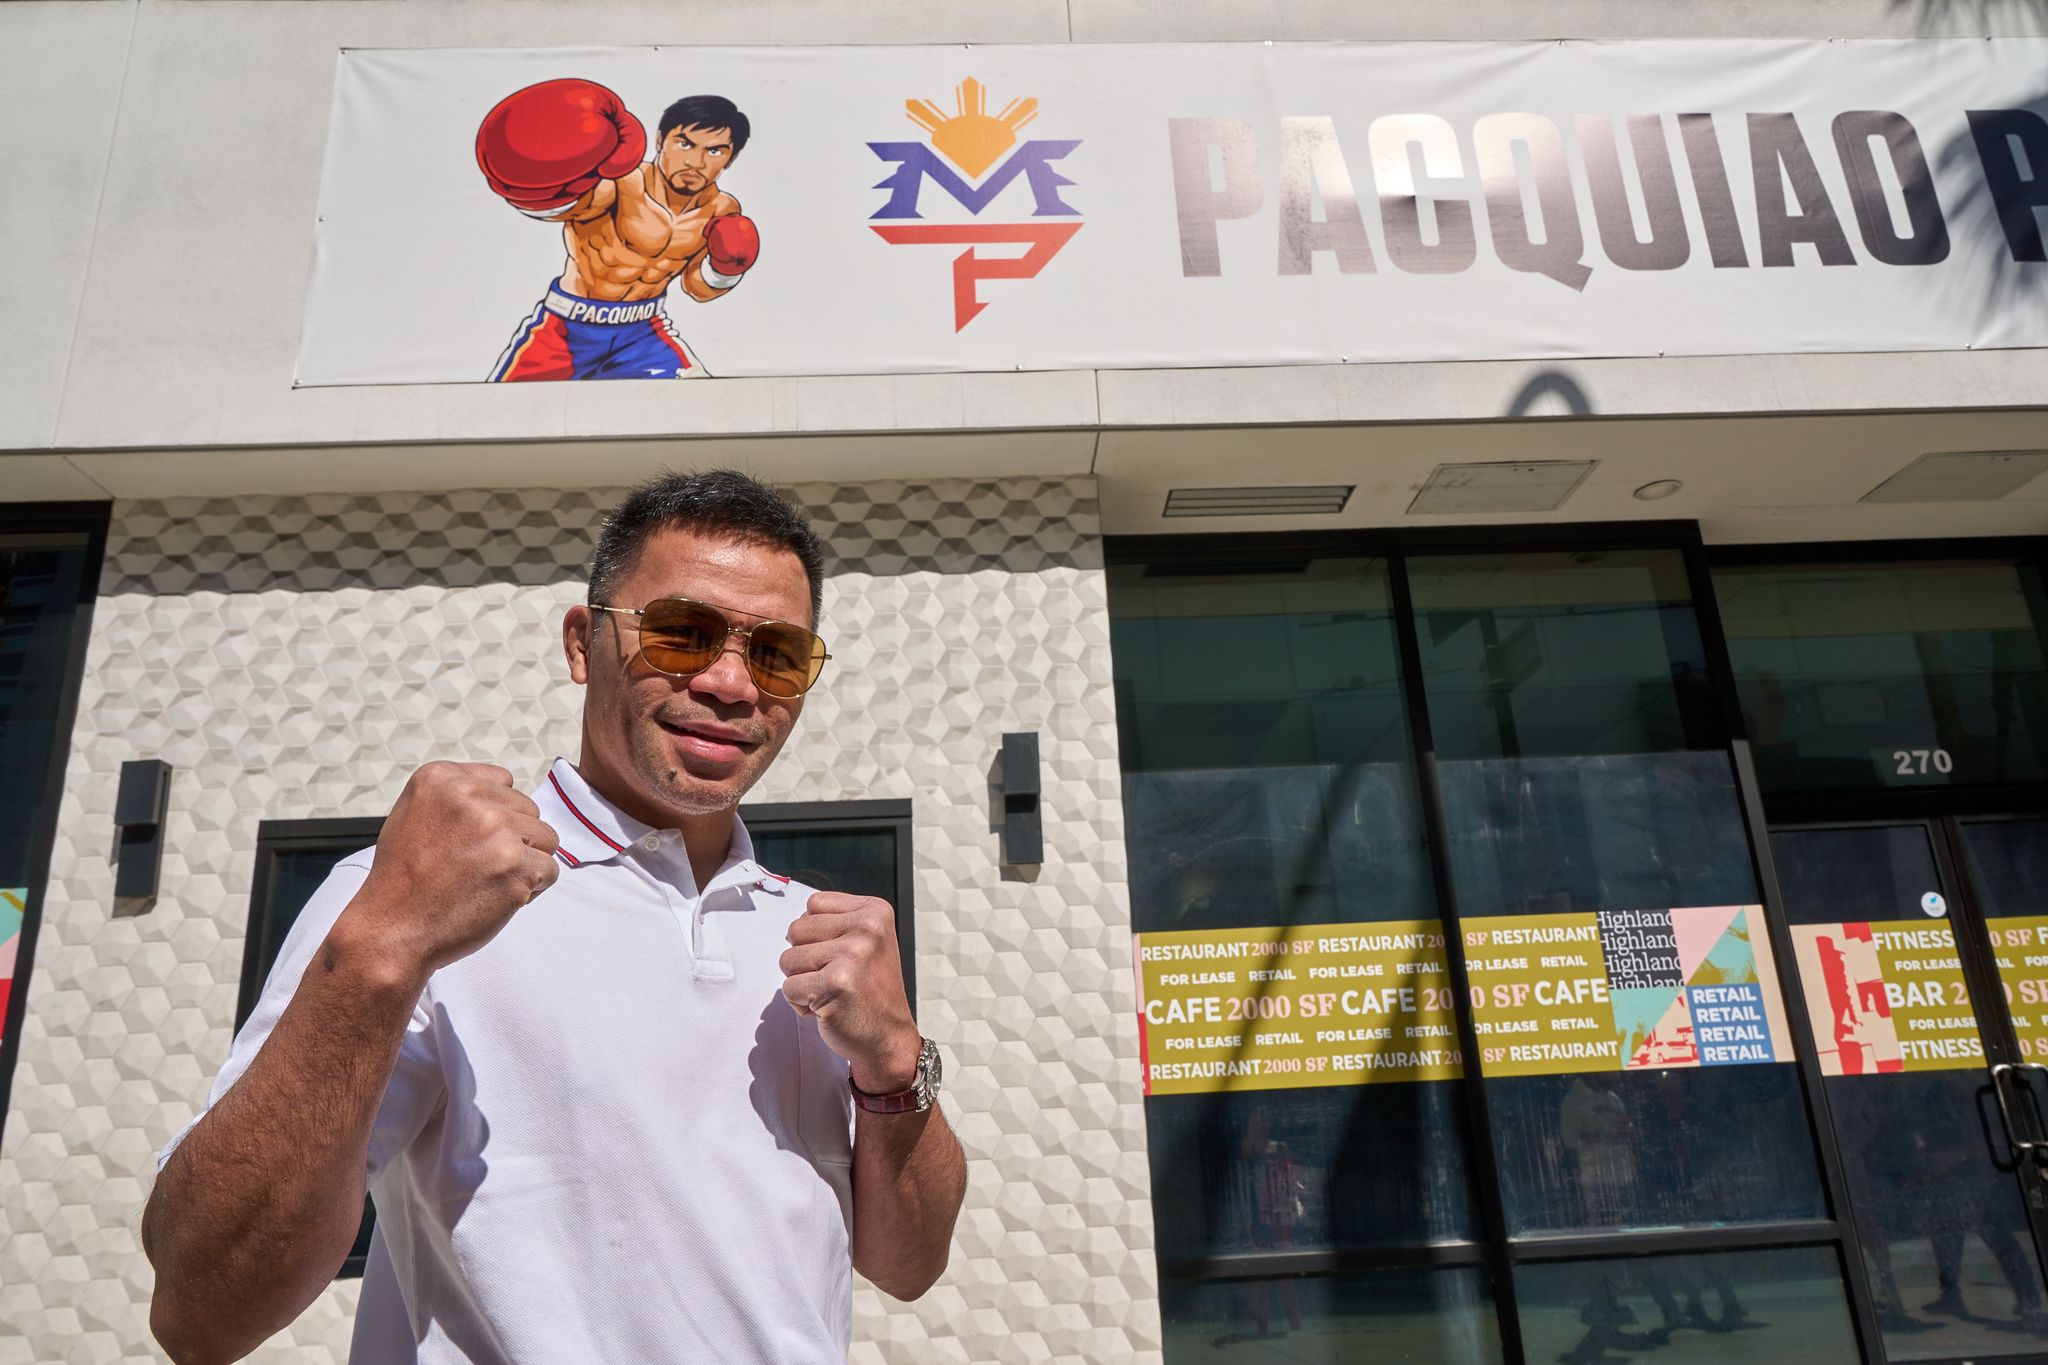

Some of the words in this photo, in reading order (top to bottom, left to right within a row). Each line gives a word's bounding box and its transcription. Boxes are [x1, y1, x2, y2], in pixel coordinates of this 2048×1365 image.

[1167, 109, 1952, 294] PACQUIAO
[569, 302, 656, 325] PACQUIAO
[1893, 749, 1953, 775] 270
[1141, 942, 1249, 961] RESTAURANT
[1251, 942, 1288, 957] 2000
[1292, 940, 1315, 955] SF
[1318, 934, 1425, 953] RESTAURANT
[1466, 932, 1488, 946] SF
[1491, 926, 1598, 945] RESTAURANT
[1871, 929, 1955, 950] FITNESS
[2005, 928, 2032, 947] SF
[1160, 974, 1188, 986] FOR
[1192, 972, 1236, 984] LEASE
[1249, 969, 1297, 982] RETAIL
[1309, 967, 1337, 978] FOR
[1340, 964, 1384, 977] LEASE
[1396, 962, 1443, 975] RETAIL
[1465, 959, 1483, 971] OR
[1485, 958, 1529, 970] LEASE
[1540, 955, 1588, 967] RETAIL
[1894, 960, 1921, 971] FOR
[1922, 958, 1962, 970] LEASE
[1146, 997, 1222, 1025] CAFE
[1226, 995, 1291, 1021] 2000
[1299, 993, 1337, 1018] SF
[1341, 988, 1417, 1015] CAFE
[1492, 984, 1530, 1008] SF
[1534, 978, 1610, 1006] CAFE
[1692, 987, 1757, 1004] RETAIL
[1884, 981, 1947, 1008] BAR
[1696, 1006, 1761, 1023] RETAIL
[1908, 1019, 1935, 1031] FOR
[1937, 1017, 1978, 1029] LEASE
[1165, 1038, 1194, 1050] FOR
[1197, 1036, 1242, 1048] LEASE
[1255, 1033, 1303, 1046] RETAIL
[1316, 1031, 1345, 1042] FOR
[1348, 1028, 1392, 1041] LEASE
[1405, 1025, 1452, 1038] RETAIL
[1474, 1022, 1492, 1034] OR
[1495, 1020, 1538, 1033] LEASE
[1551, 1018, 1599, 1030] RETAIL
[1700, 1025, 1765, 1043] RETAIL
[1704, 1044, 1769, 1062] RETAIL
[1898, 1037, 1984, 1060] FITNESS
[1150, 1060, 1261, 1081] RESTAURANT
[1263, 1057, 1300, 1074] 2000
[1305, 1056, 1328, 1072] SF
[1332, 1050, 1441, 1071] RESTAURANT
[1483, 1048, 1506, 1063] SF
[1509, 1041, 1618, 1061] RESTAURANT
